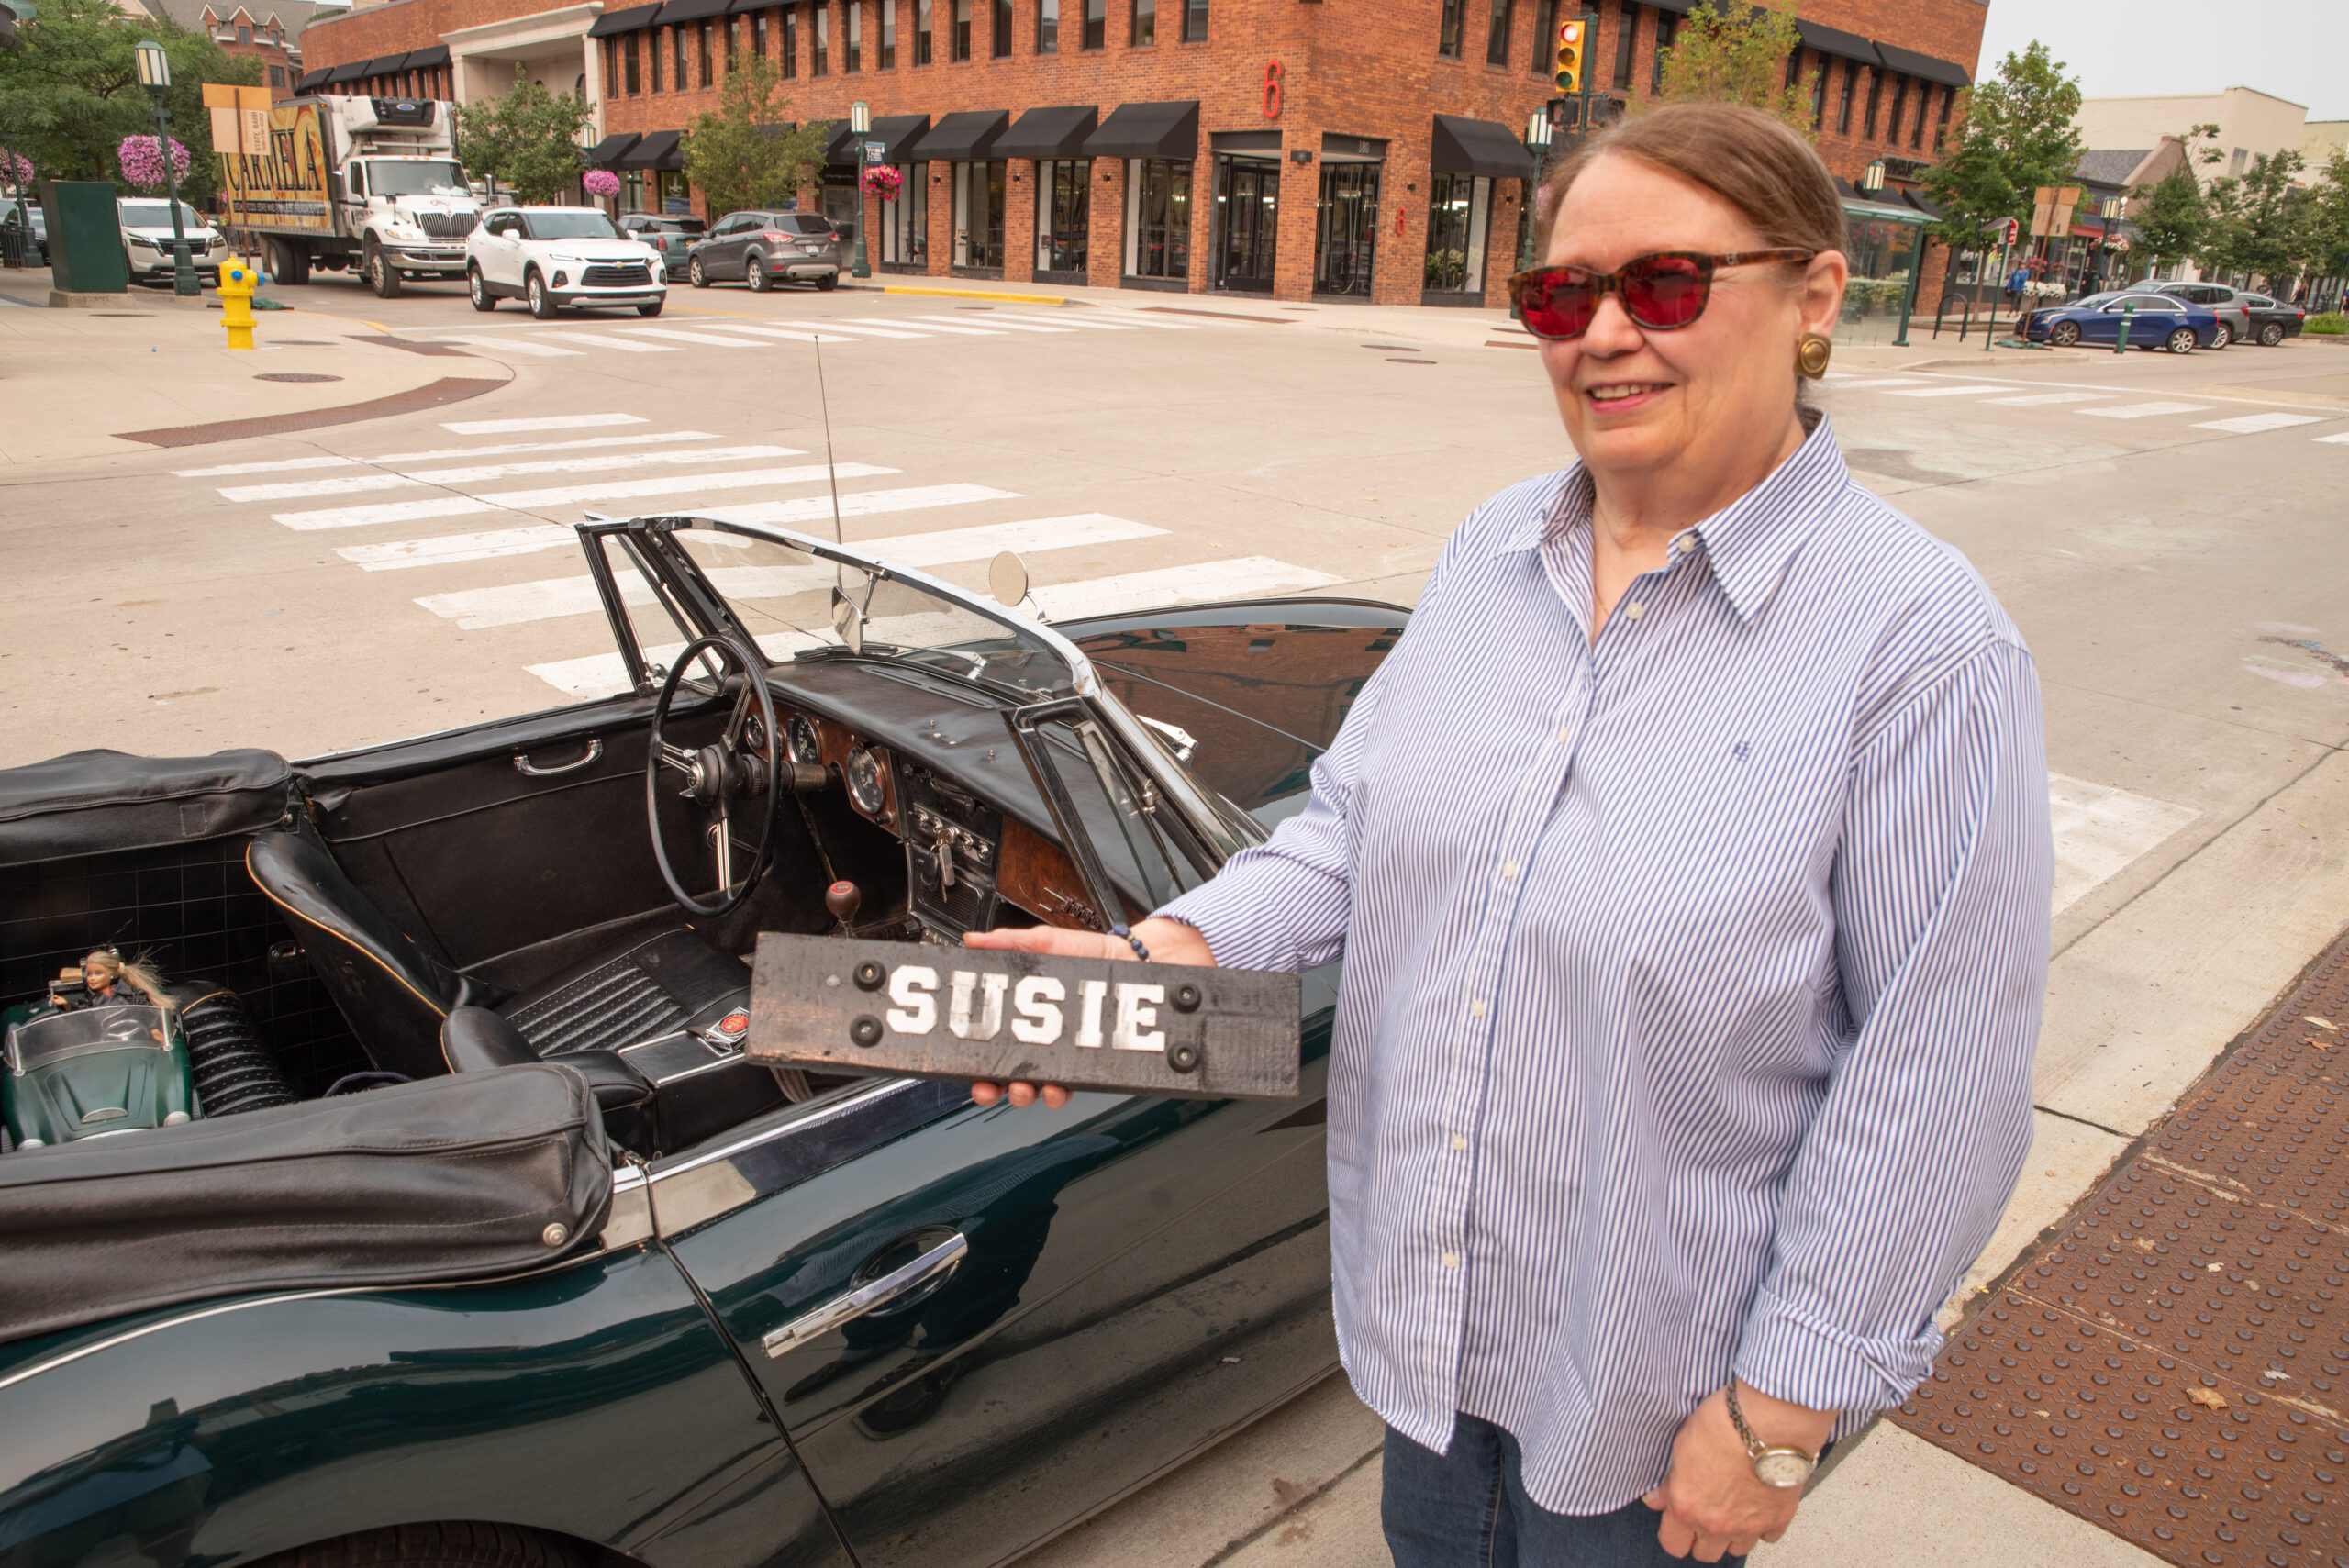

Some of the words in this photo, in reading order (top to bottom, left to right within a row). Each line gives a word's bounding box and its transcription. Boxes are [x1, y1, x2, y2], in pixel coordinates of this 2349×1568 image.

[1263, 60, 1281, 118] 6
[253, 132, 262, 152] STATE
[1397, 207, 1406, 236] 6
[885, 964, 1166, 1052] SUSIE
